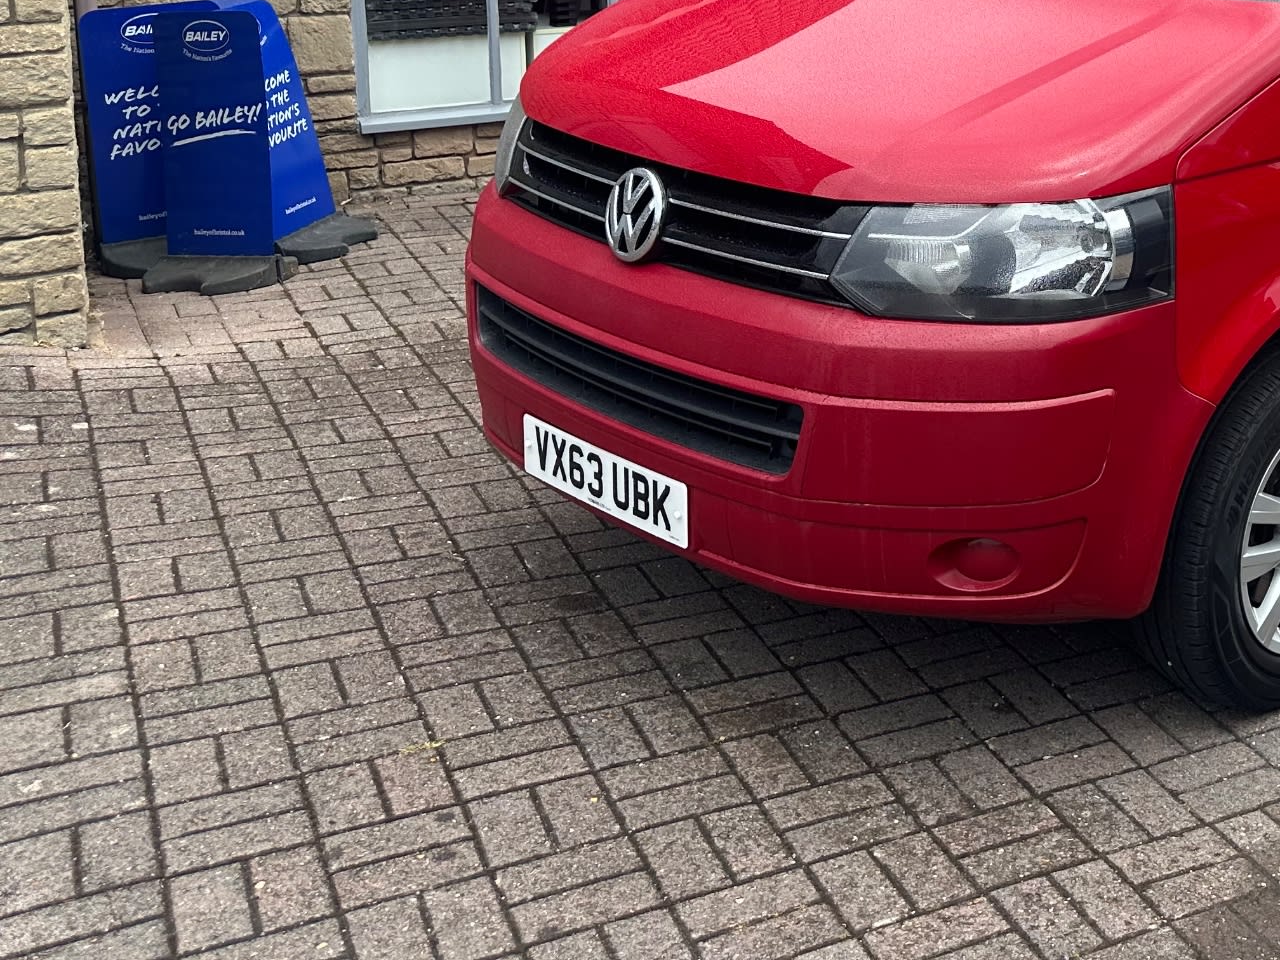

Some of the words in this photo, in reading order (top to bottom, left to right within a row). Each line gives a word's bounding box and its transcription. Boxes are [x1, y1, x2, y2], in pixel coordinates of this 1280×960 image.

[185, 30, 227, 41] BAILEY
[270, 89, 290, 107] THE
[122, 104, 151, 120] TO
[167, 114, 190, 136] GO
[195, 102, 262, 130] BAILEY!
[267, 102, 300, 131] TION'S
[535, 424, 604, 499] VX63
[612, 461, 671, 532] UBK
